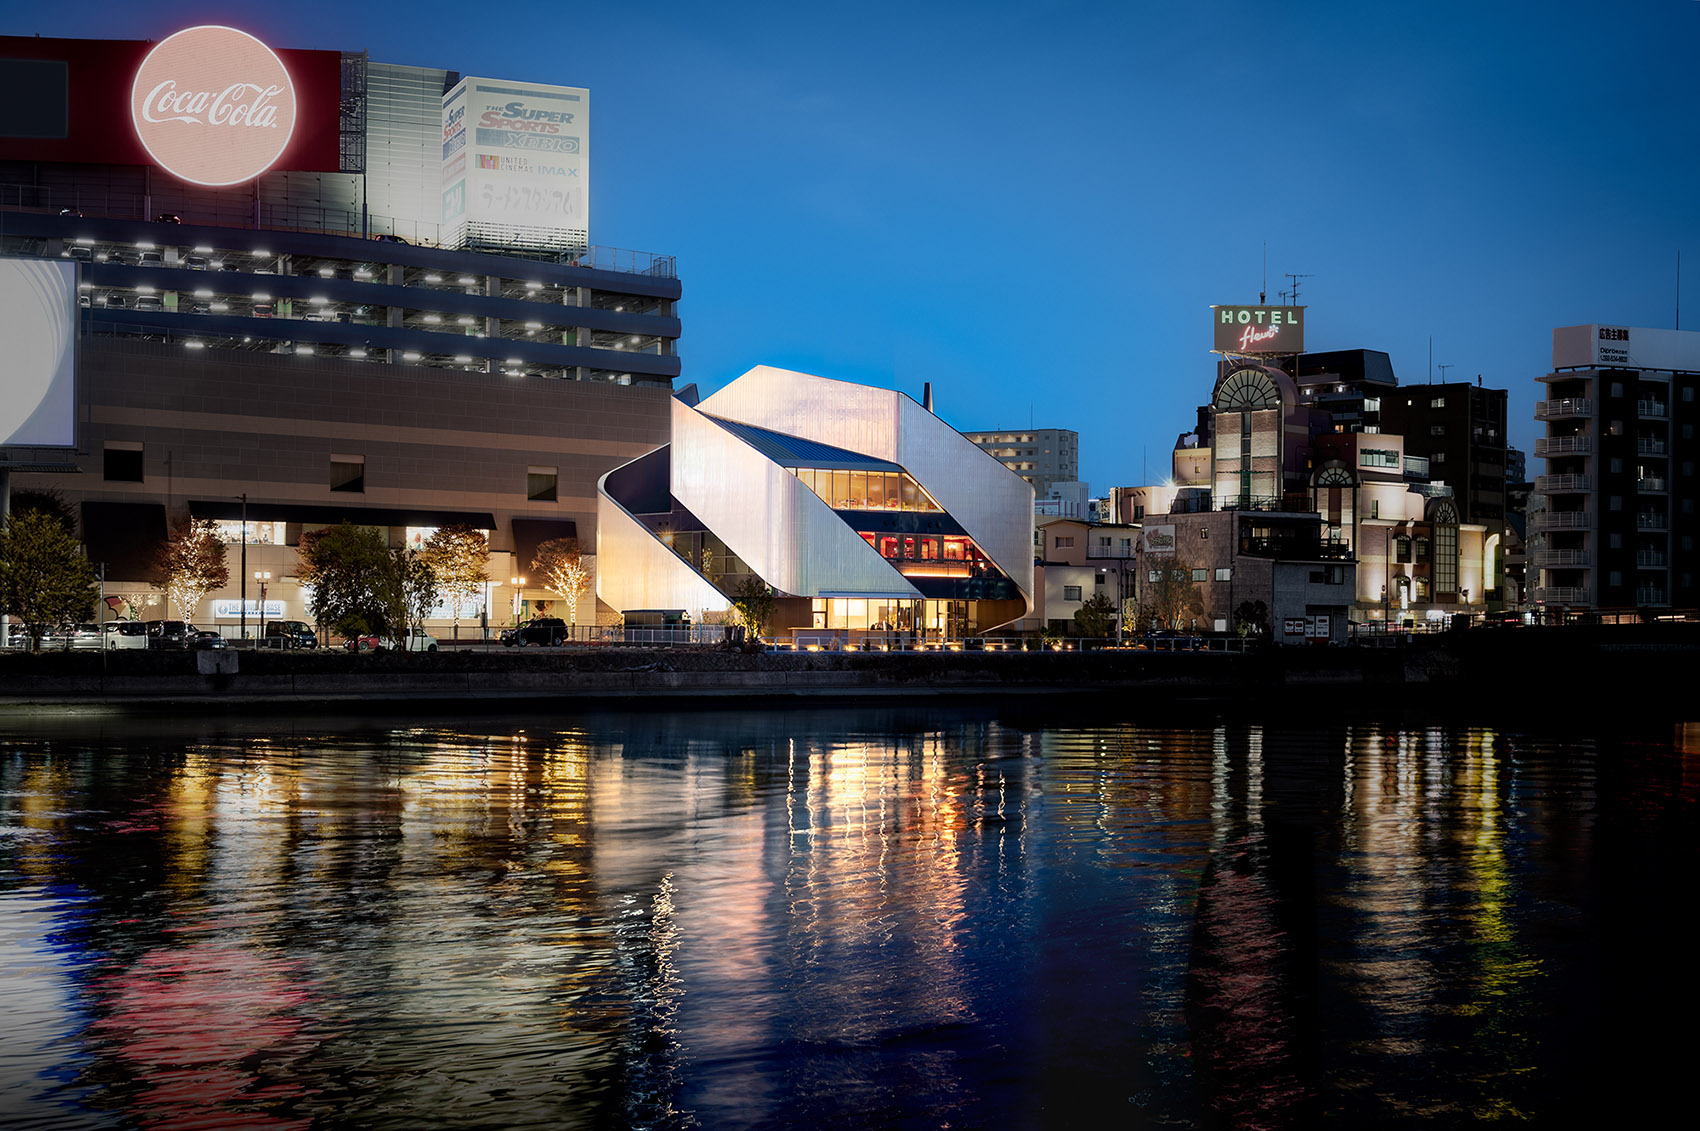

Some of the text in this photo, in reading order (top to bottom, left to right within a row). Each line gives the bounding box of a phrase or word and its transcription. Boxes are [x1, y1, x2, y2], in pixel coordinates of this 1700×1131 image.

[142, 80, 285, 128] Coca-Cola
[504, 132, 579, 152] XEBIO
[500, 156, 528, 165] UNITED
[500, 164, 533, 174] CINEMAS
[537, 165, 577, 177] IMAX
[1221, 310, 1298, 324] HOTEL
